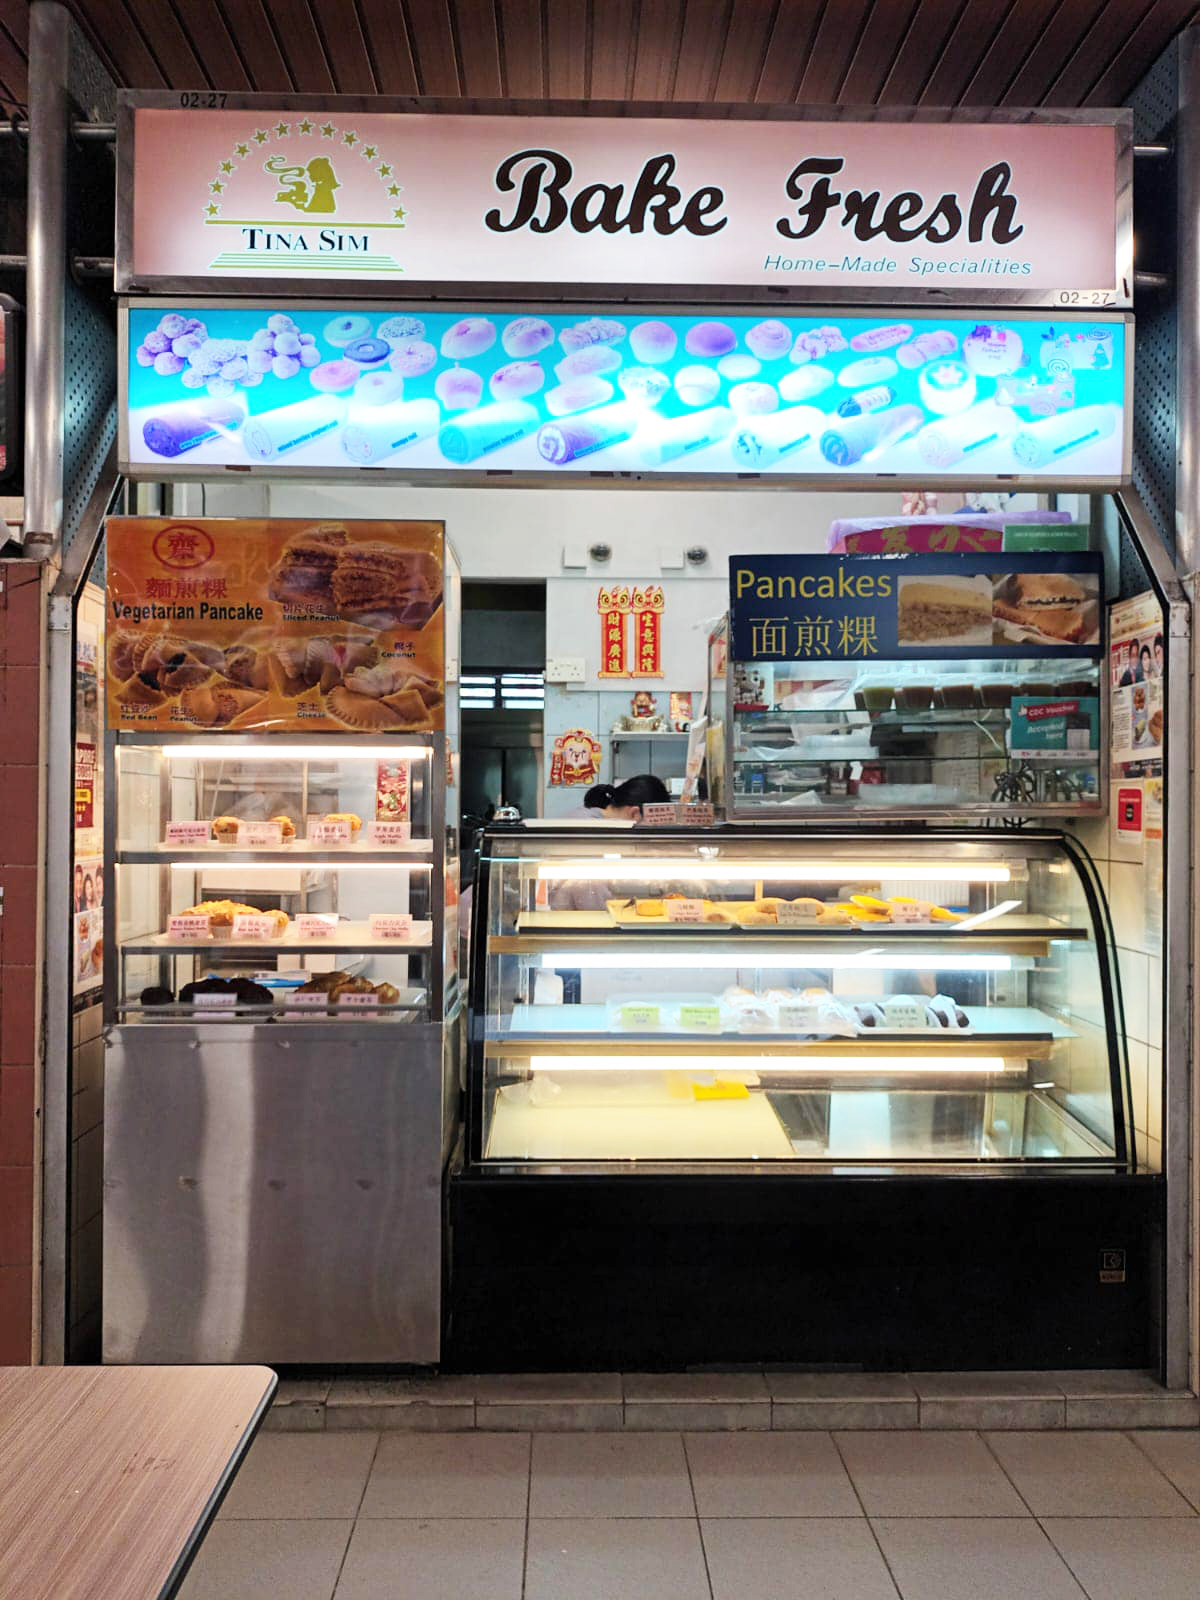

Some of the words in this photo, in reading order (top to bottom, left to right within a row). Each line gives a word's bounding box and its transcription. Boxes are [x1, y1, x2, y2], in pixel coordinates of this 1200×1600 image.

[181, 92, 228, 109] 02-27
[485, 149, 728, 236] Bake
[776, 157, 1023, 245] Fresh
[908, 256, 1032, 276] Specialities
[1060, 291, 1110, 305] 02-27
[736, 567, 892, 599] Pancakes
[112, 602, 195, 624] Vegetarian
[199, 603, 263, 621] Pancake
[748, 616, 879, 658] 面煎粿
